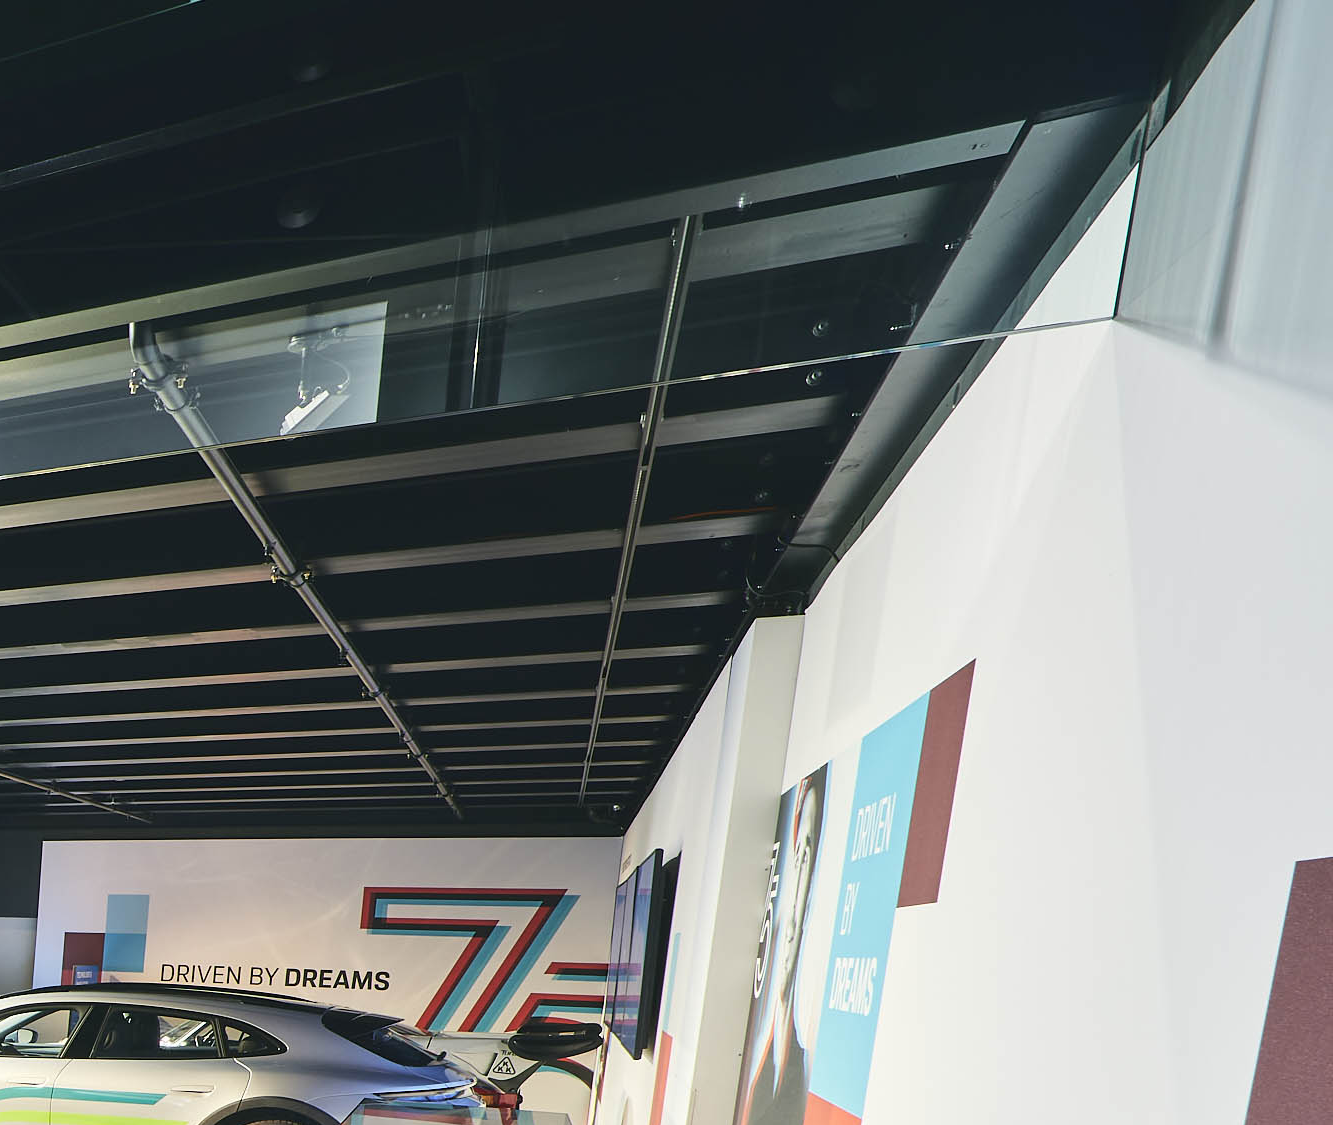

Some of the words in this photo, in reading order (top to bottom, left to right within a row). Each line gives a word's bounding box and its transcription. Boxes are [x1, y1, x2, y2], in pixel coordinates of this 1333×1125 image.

[851, 792, 897, 862] DRIVEN
[840, 881, 860, 936] BY
[160, 964, 242, 985] DRIVEN
[249, 966, 280, 986] BY
[284, 968, 390, 991] DREAMS
[829, 957, 877, 1017] DREAMS
